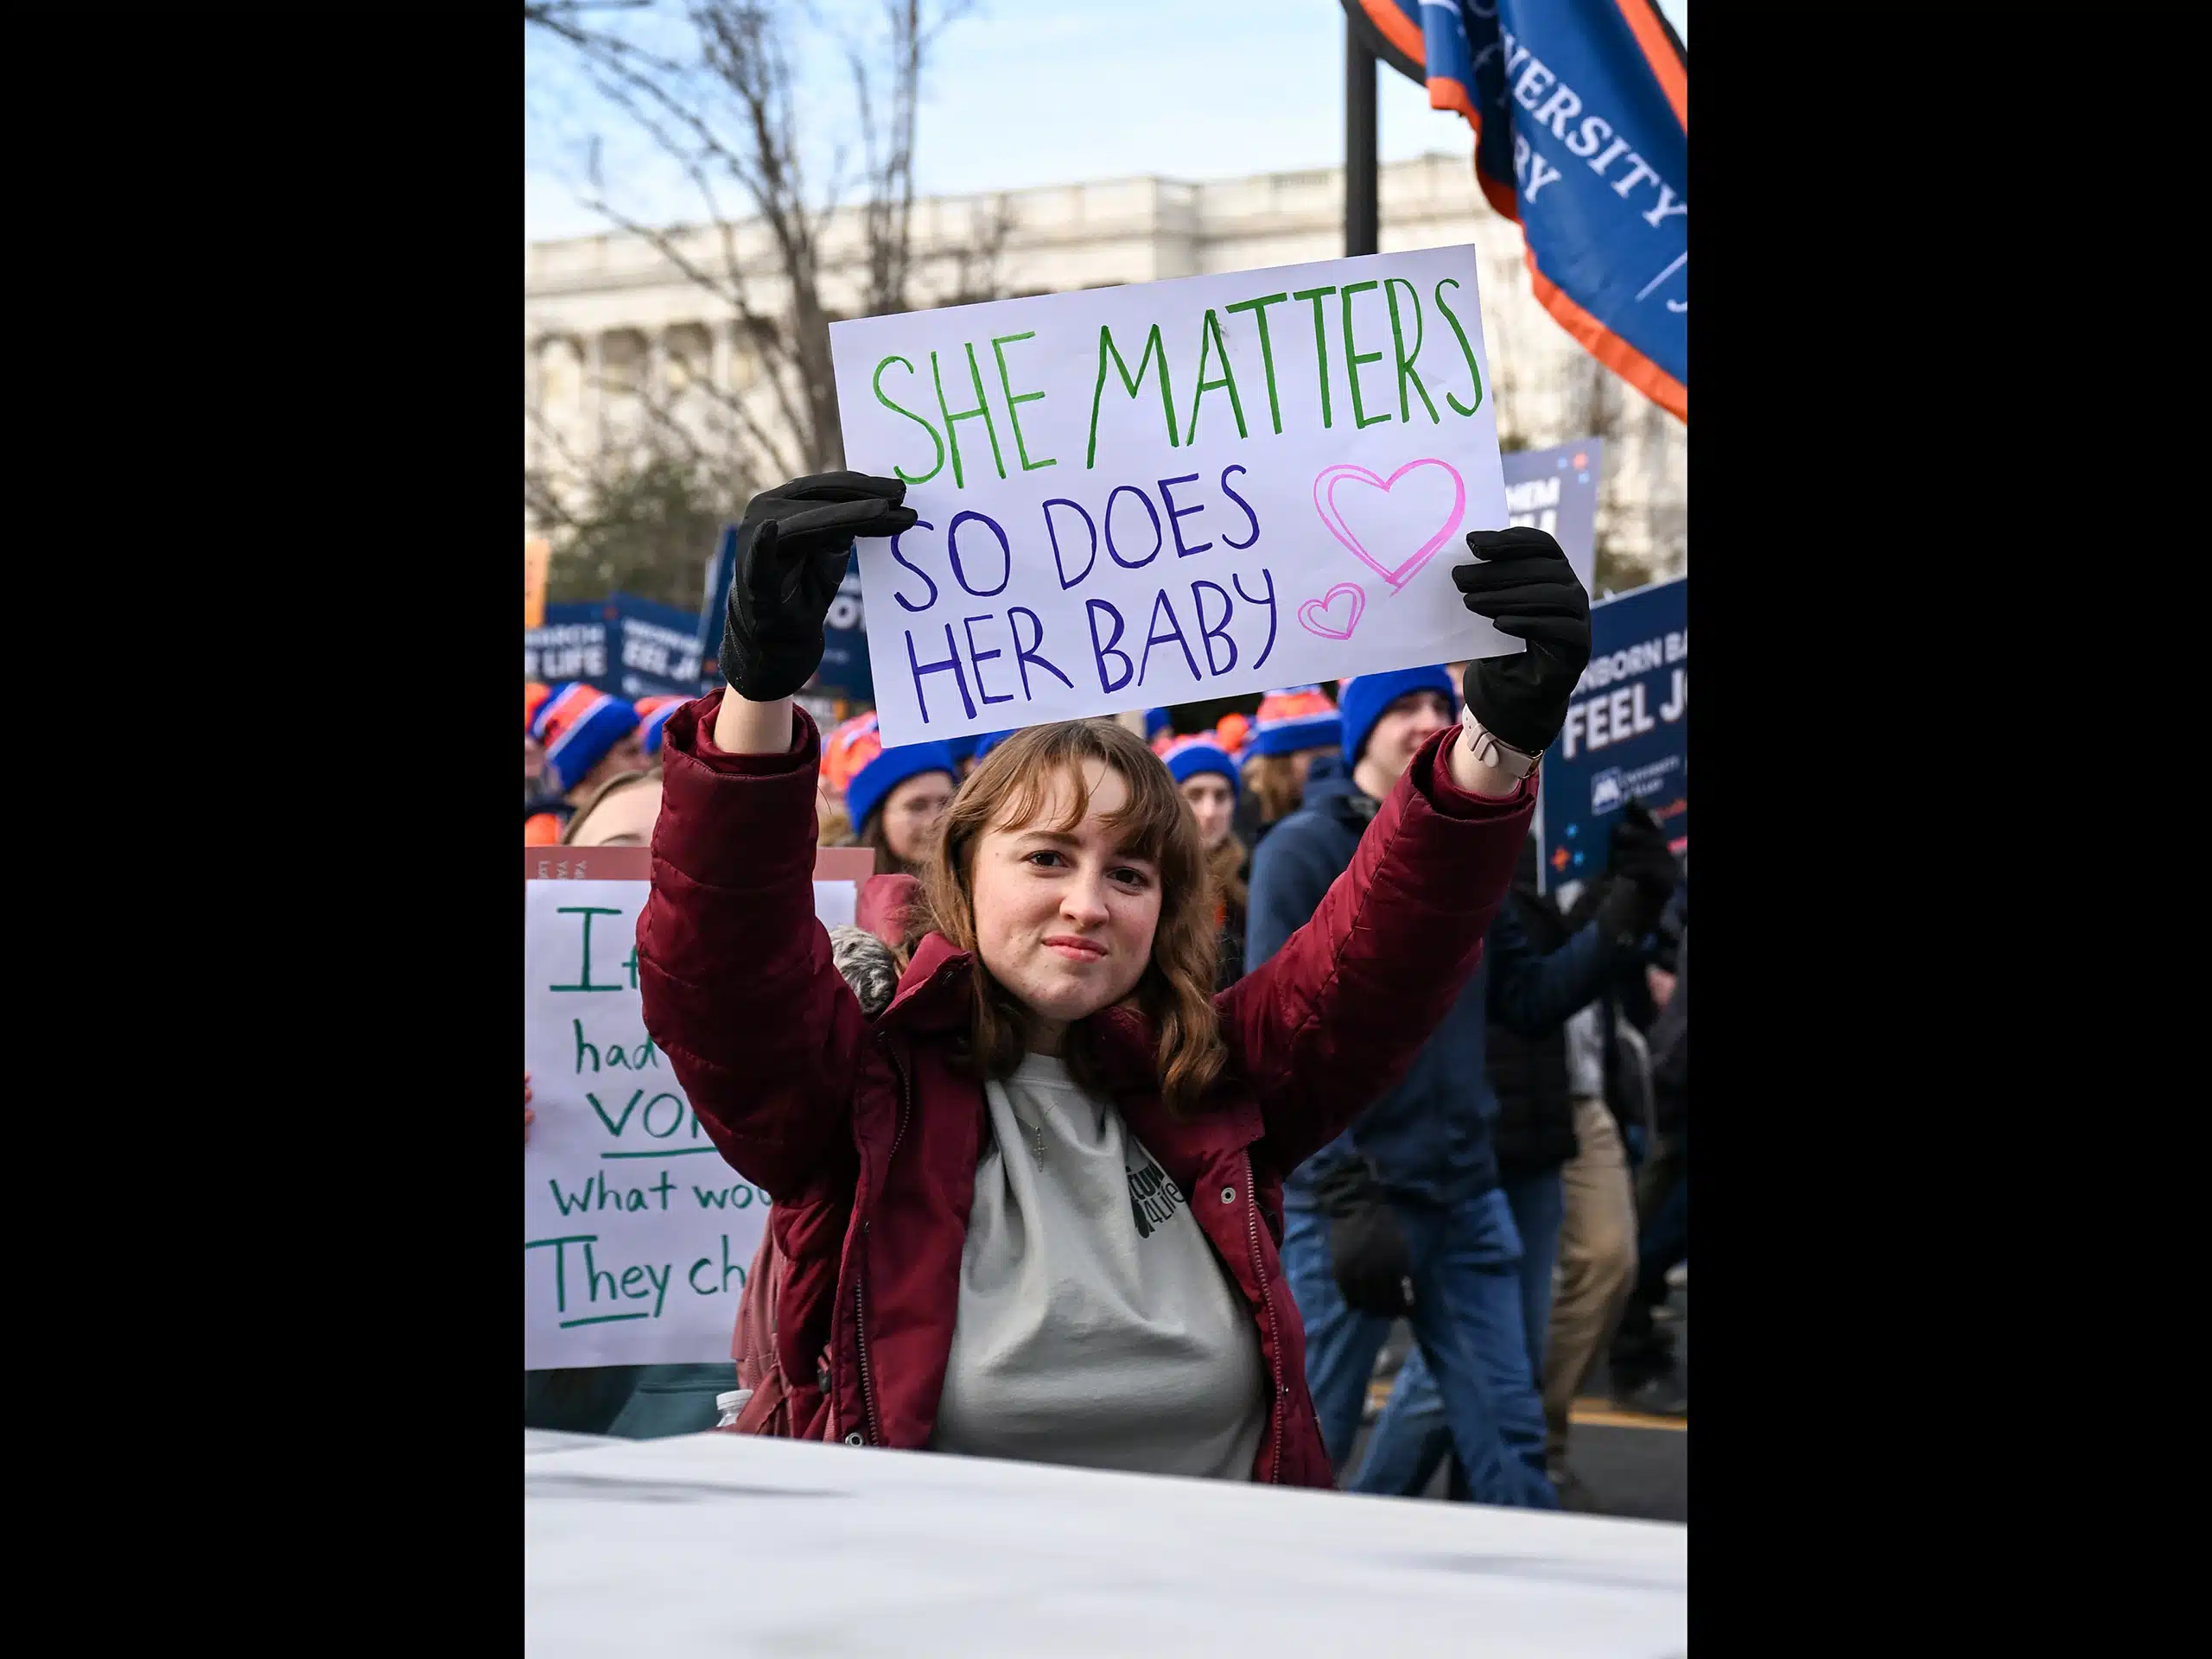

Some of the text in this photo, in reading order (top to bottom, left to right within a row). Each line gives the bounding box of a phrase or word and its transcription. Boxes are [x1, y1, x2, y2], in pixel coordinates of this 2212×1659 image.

[1503, 30, 1687, 229] VERSITY
[873, 277, 1484, 489] SHE MATTERS
[890, 464, 1262, 613] SO DOES
[905, 568, 1278, 724] HER BABY
[1571, 636, 1663, 697] NBORN
[1561, 667, 1688, 760] FEEL J
[573, 1018, 658, 1074] had
[524, 1234, 672, 1319] They
